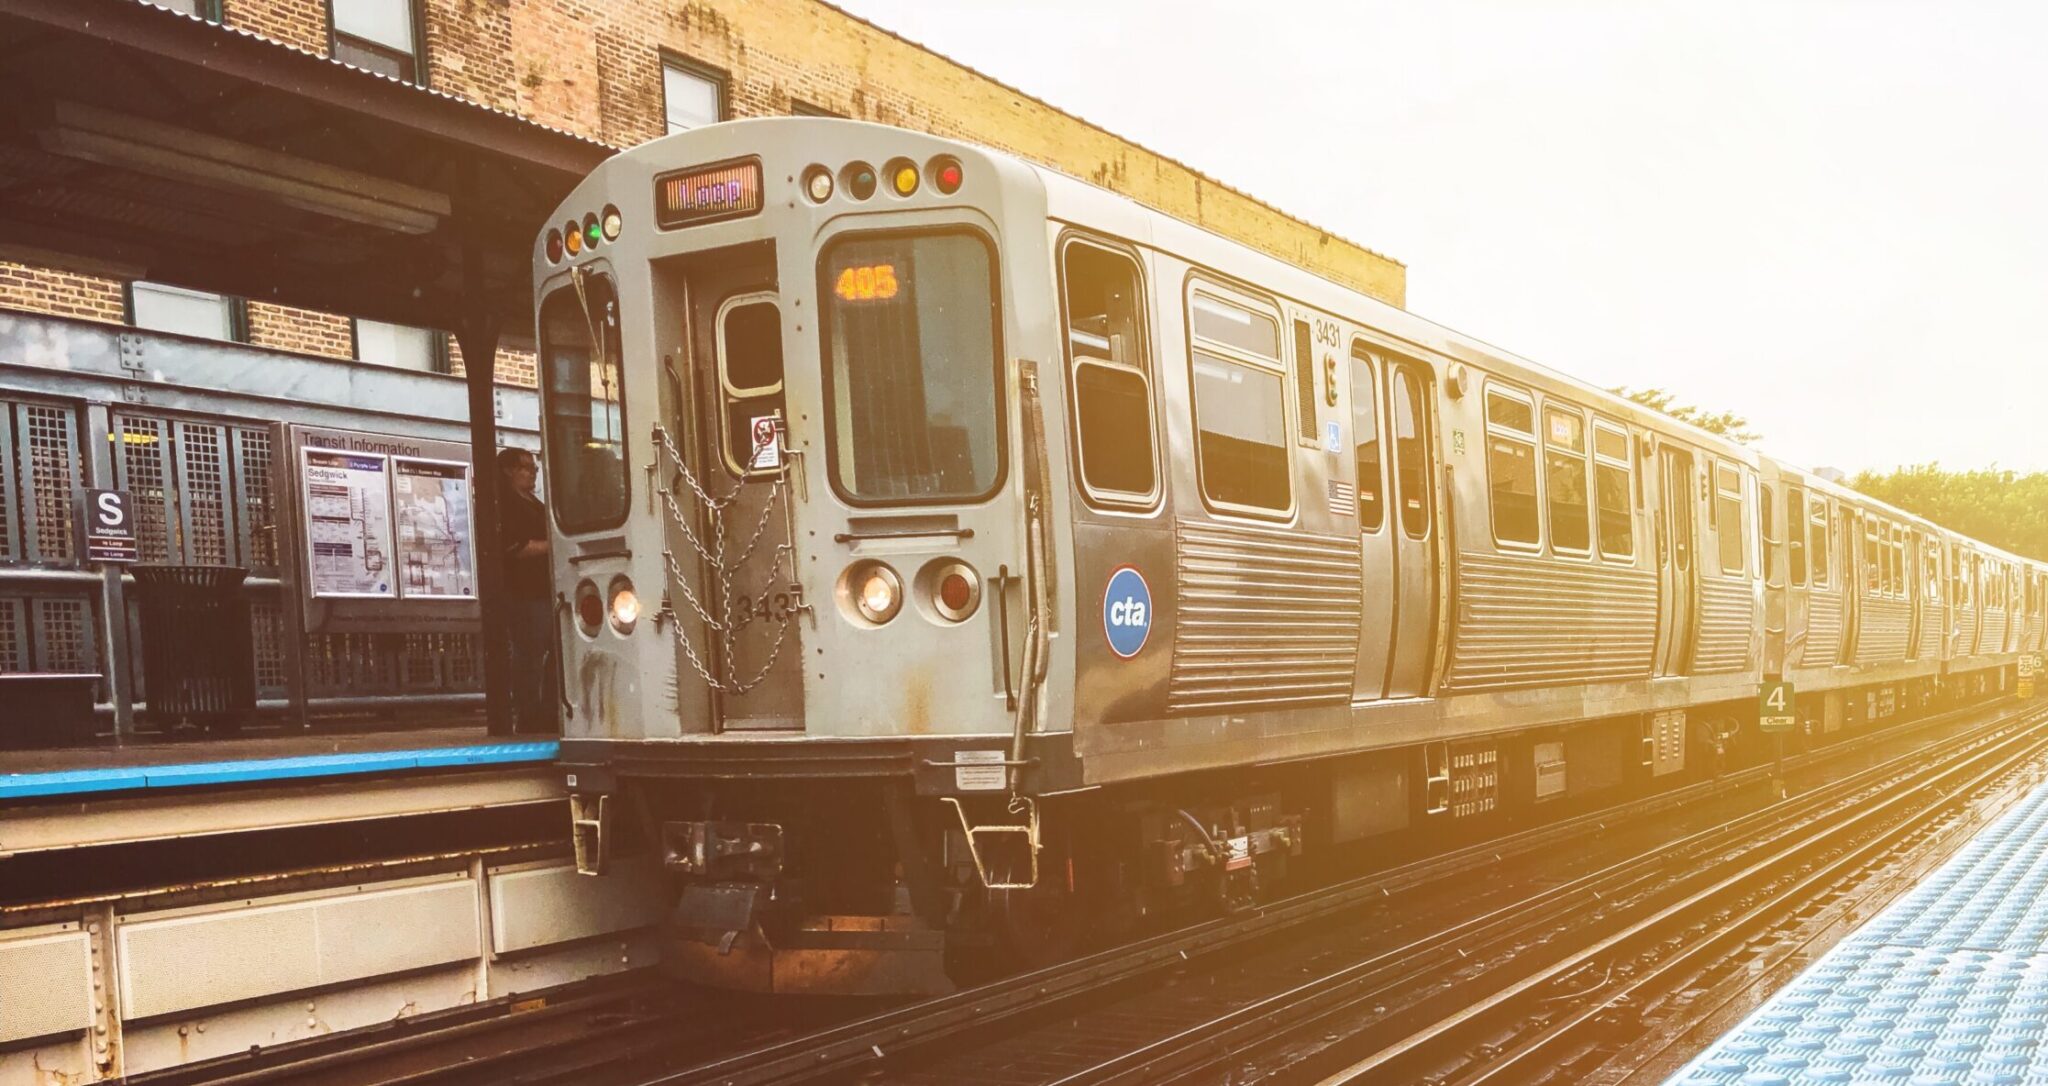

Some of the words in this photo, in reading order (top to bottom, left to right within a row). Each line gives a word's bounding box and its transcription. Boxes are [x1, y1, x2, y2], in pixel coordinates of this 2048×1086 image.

[681, 180, 741, 209] Loop
[1316, 318, 1341, 349] 3431
[302, 432, 346, 450] Transit
[350, 436, 420, 457] Information
[308, 468, 347, 480] Sedgwick
[98, 493, 123, 525] S
[95, 527, 127, 536] Sedgwick
[1111, 596, 1146, 627] cta
[2034, 656, 2042, 668] 6
[1767, 686, 1786, 711] 4
